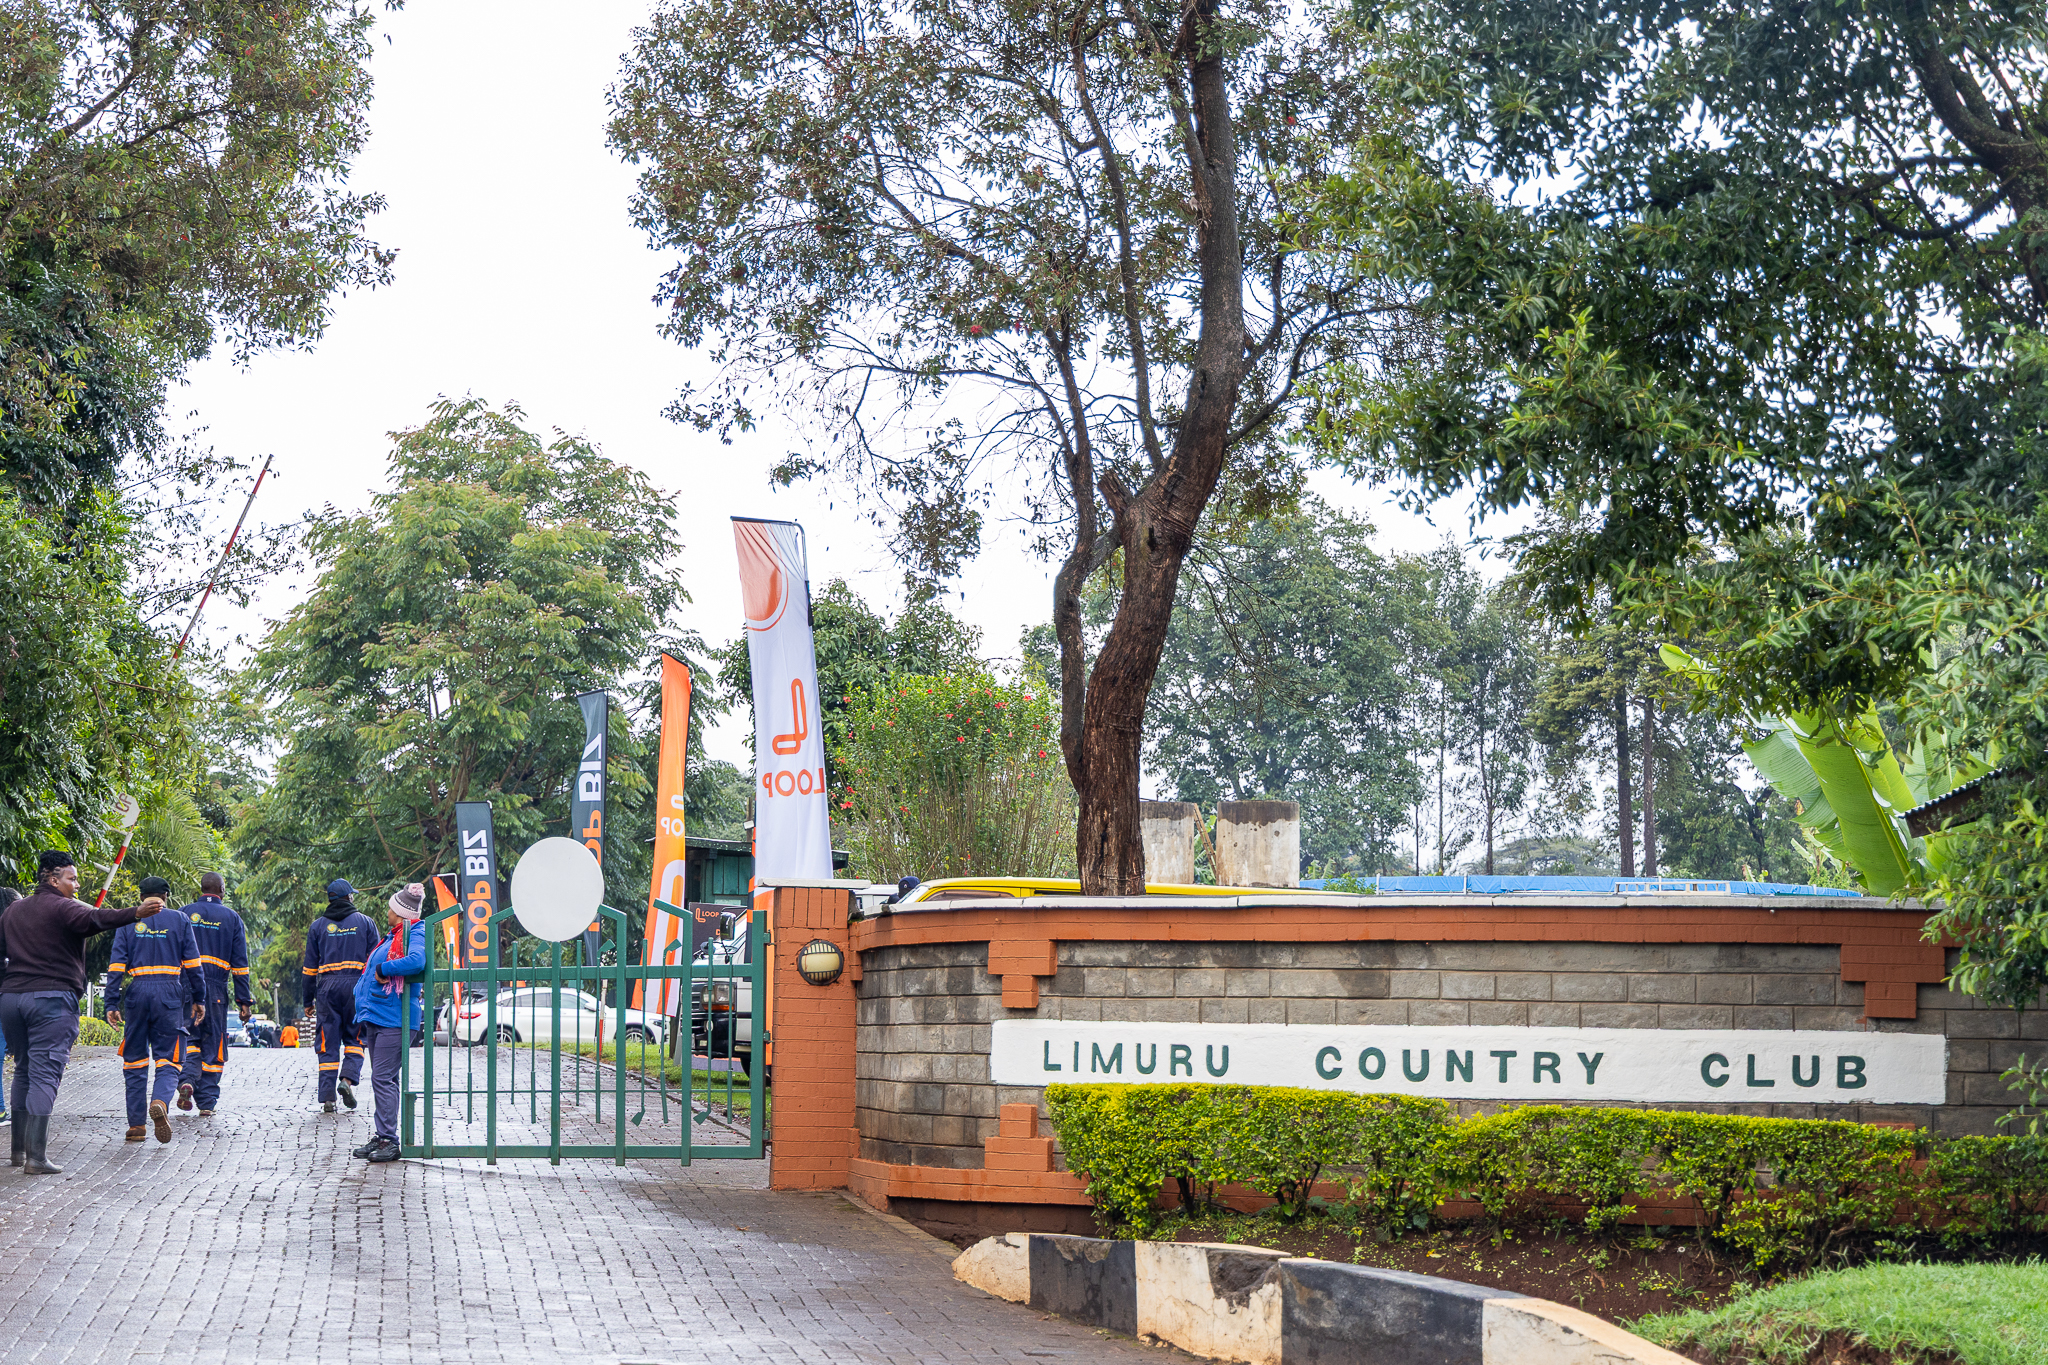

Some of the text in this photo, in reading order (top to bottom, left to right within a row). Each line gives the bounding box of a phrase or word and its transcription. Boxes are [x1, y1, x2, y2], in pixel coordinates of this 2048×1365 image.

[1044, 1040, 1867, 1089] LIMURU COUNTRY CLUB
